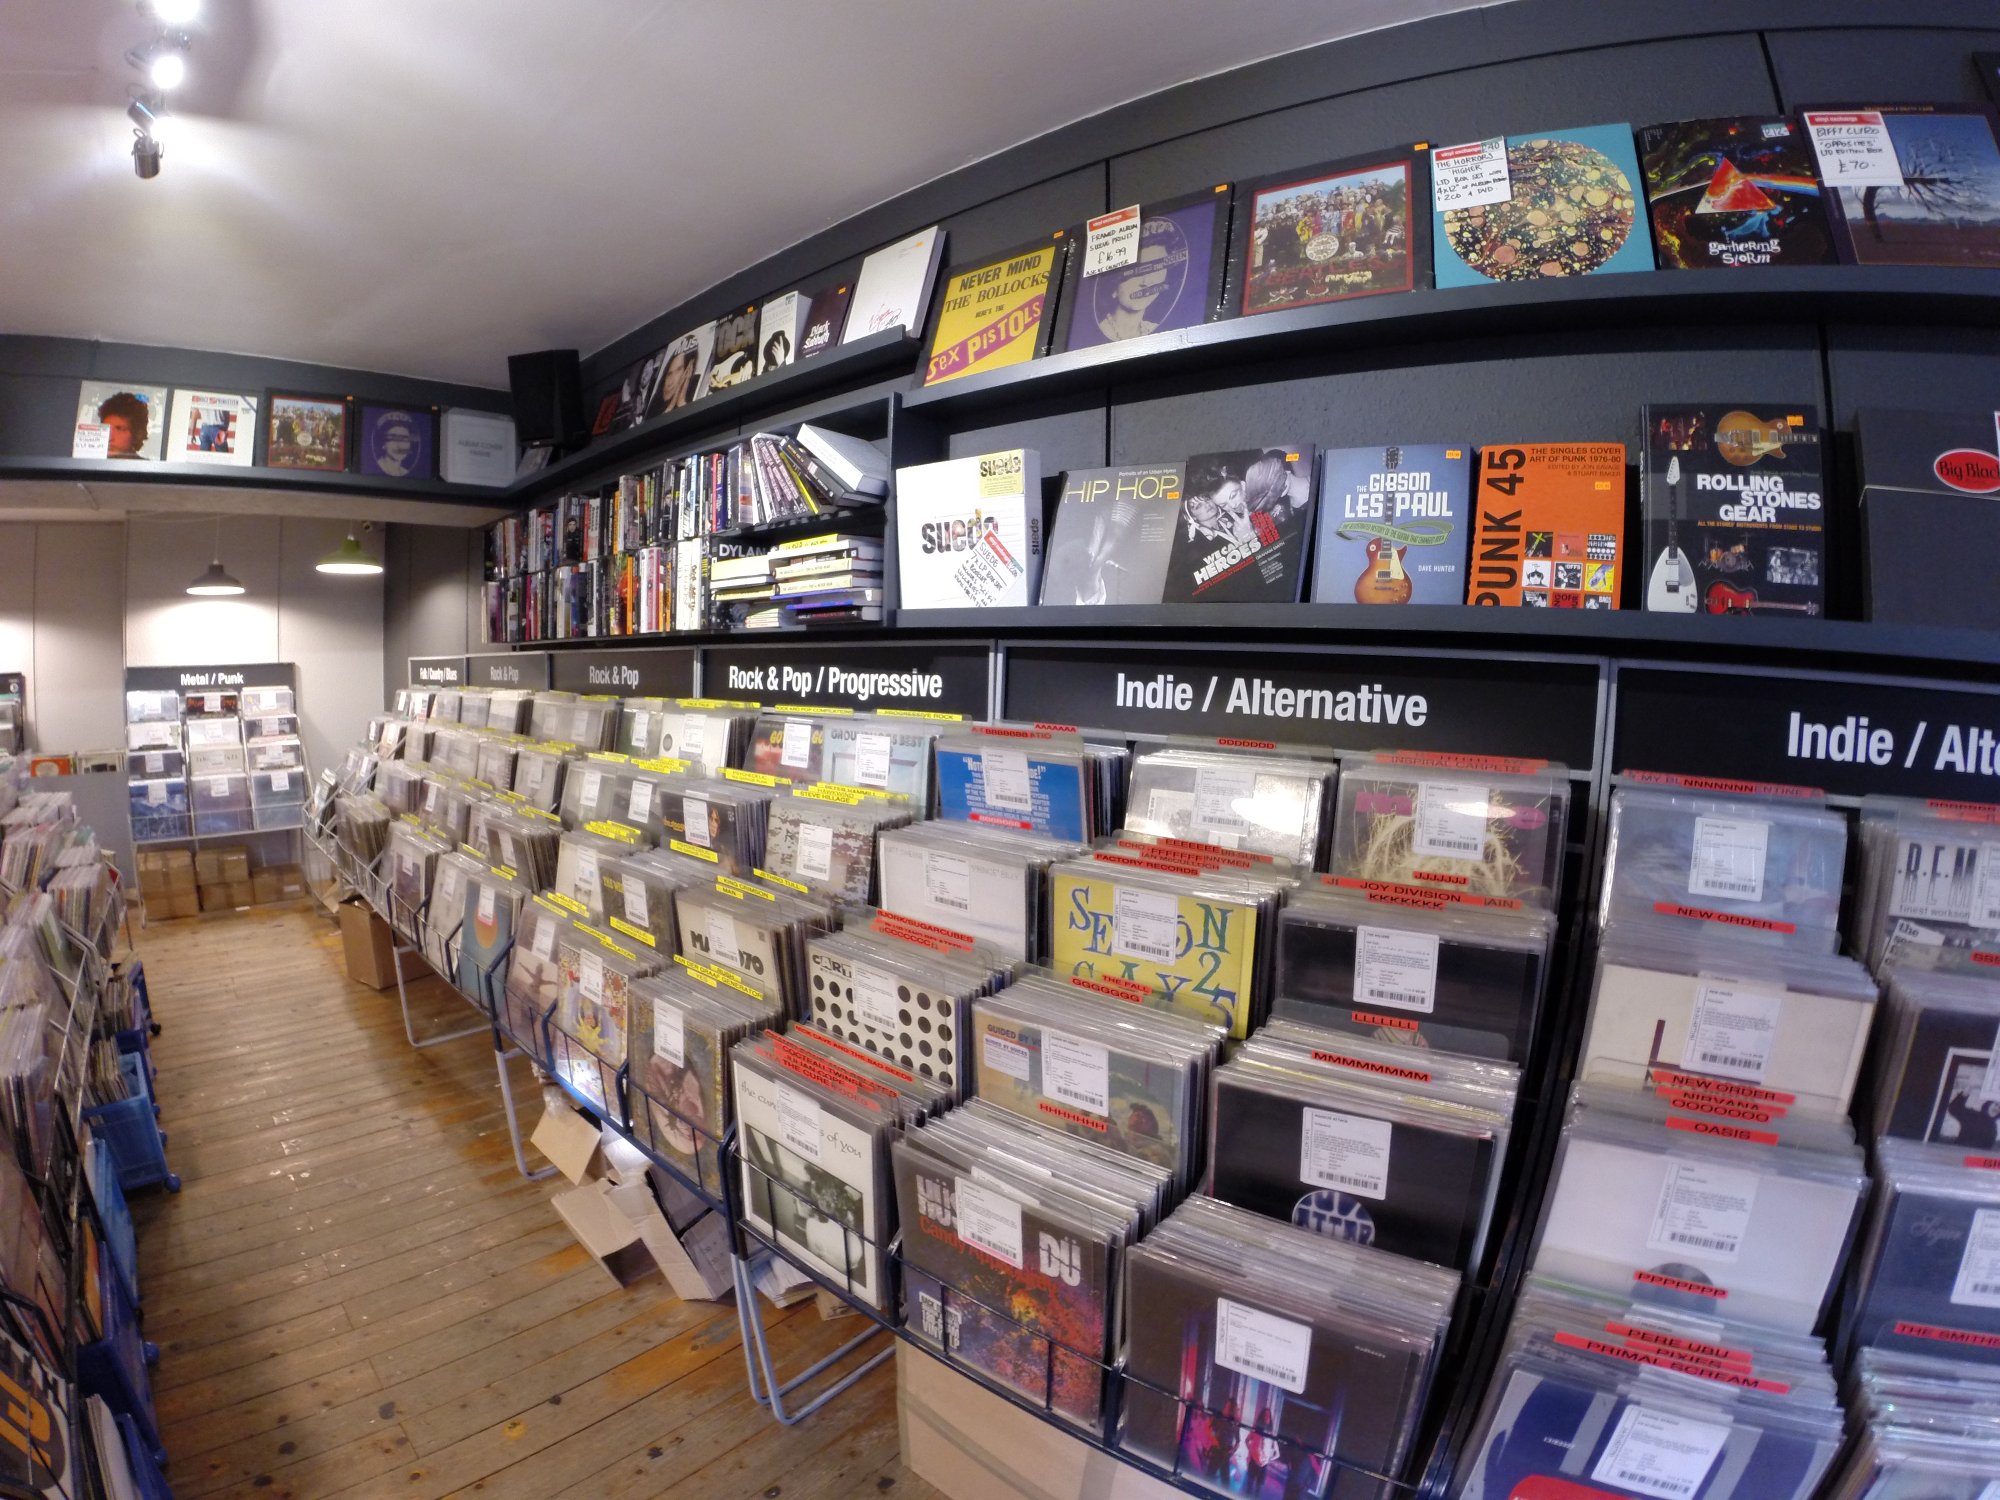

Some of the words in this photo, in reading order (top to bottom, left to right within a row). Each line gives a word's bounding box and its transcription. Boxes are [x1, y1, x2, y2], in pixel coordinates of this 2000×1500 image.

[1436, 160, 1451, 169] THE
[1453, 153, 1494, 166] HORRORS
[959, 266, 1002, 292] NEVER
[1006, 254, 1042, 277] MIND
[945, 293, 971, 314] THE
[976, 270, 1050, 304] BOLLOCKS
[1529, 455, 1546, 463] ART
[1548, 455, 1560, 463] OF
[1562, 455, 1586, 463] PUNK
[1589, 455, 1621, 463] 1976-80
[1531, 447, 1547, 455] THE
[1549, 447, 1588, 455] SINGLES
[1590, 447, 1621, 455] COVER
[1487, 448, 1526, 496] 45
[1939, 460, 1963, 481] Big
[1064, 479, 1110, 504] HIP
[1115, 474, 1179, 501] HOP
[1356, 484, 1368, 493] THE
[1368, 471, 1431, 493] GIBSON
[1696, 473, 1785, 493] ROLLING
[1344, 493, 1384, 518] LES
[1395, 491, 1453, 518] PAUL
[1740, 490, 1821, 510] STONES
[1719, 504, 1776, 523] GEAR
[1030, 518, 1040, 556] suede
[719, 543, 767, 557] DYLAN
[1203, 549, 1221, 565] WE
[1193, 537, 1262, 586] HEROES
[1417, 564, 1434, 573] DAVE
[1435, 564, 1456, 573] HUNTER
[180, 673, 209, 686] Metal
[218, 672, 244, 685] Punk
[490, 666, 503, 681] Rock
[509, 669, 519, 684] Pop
[589, 666, 611, 684] Rock
[612, 668, 620, 685] &
[621, 668, 639, 689] Pop
[728, 665, 764, 691] Rock
[767, 667, 779, 692] &
[783, 669, 810, 695] Pop
[815, 667, 825, 693] /
[829, 667, 943, 701] Progressive
[1116, 672, 1193, 711] Indie
[1201, 675, 1218, 712] /
[1225, 677, 1428, 727] Alternative
[884, 709, 932, 719] PROGRESSIVE
[934, 713, 956, 721] ROCK
[899, 734, 925, 748] BEST
[1787, 711, 1894, 766] Indie
[1904, 721, 1927, 769] /
[800, 791, 820, 799] STEVE
[820, 793, 851, 803] HILLAGE
[1096, 853, 1143, 867] FACTORY
[1147, 861, 1199, 876] RECORDS
[722, 887, 737, 897] MAN
[723, 879, 738, 888] KING
[738, 883, 769, 898] CRIMSON
[784, 881, 800, 890] TULL
[1360, 881, 1390, 891] JOY
[1393, 884, 1461, 903] DIVISION
[1677, 907, 1715, 919] NEW
[1717, 914, 1774, 930] ORDER
[674, 956, 686, 966] VAN
[721, 976, 763, 999] GENERATOR
[1102, 976, 1121, 985] THE
[1124, 979, 1149, 993] FALL
[987, 1023, 1017, 1040] GUIDED
[833, 1042, 849, 1054] AND
[850, 1049, 865, 1060] THE
[867, 1057, 884, 1069] BAD
[885, 1064, 913, 1083] SEEDS
[783, 1060, 801, 1073] THE
[802, 1069, 832, 1088] CURE
[1673, 1075, 1713, 1090] NEW
[1716, 1082, 1776, 1101] ORDER
[1683, 1091, 1760, 1111] NIRVANA
[741, 1080, 756, 1097] the
[826, 1131, 839, 1150] of
[839, 1141, 862, 1159] you
[1694, 1122, 1751, 1141] OASIS
[1901, 1324, 1926, 1336] THE
[1628, 1328, 1683, 1350] PERE
[1687, 1341, 1730, 1359] UBU
[1586, 1340, 1659, 1368] PRIMAL
[1669, 1360, 1760, 1390] SCREAM
[1656, 1348, 1722, 1370] PIXIES
